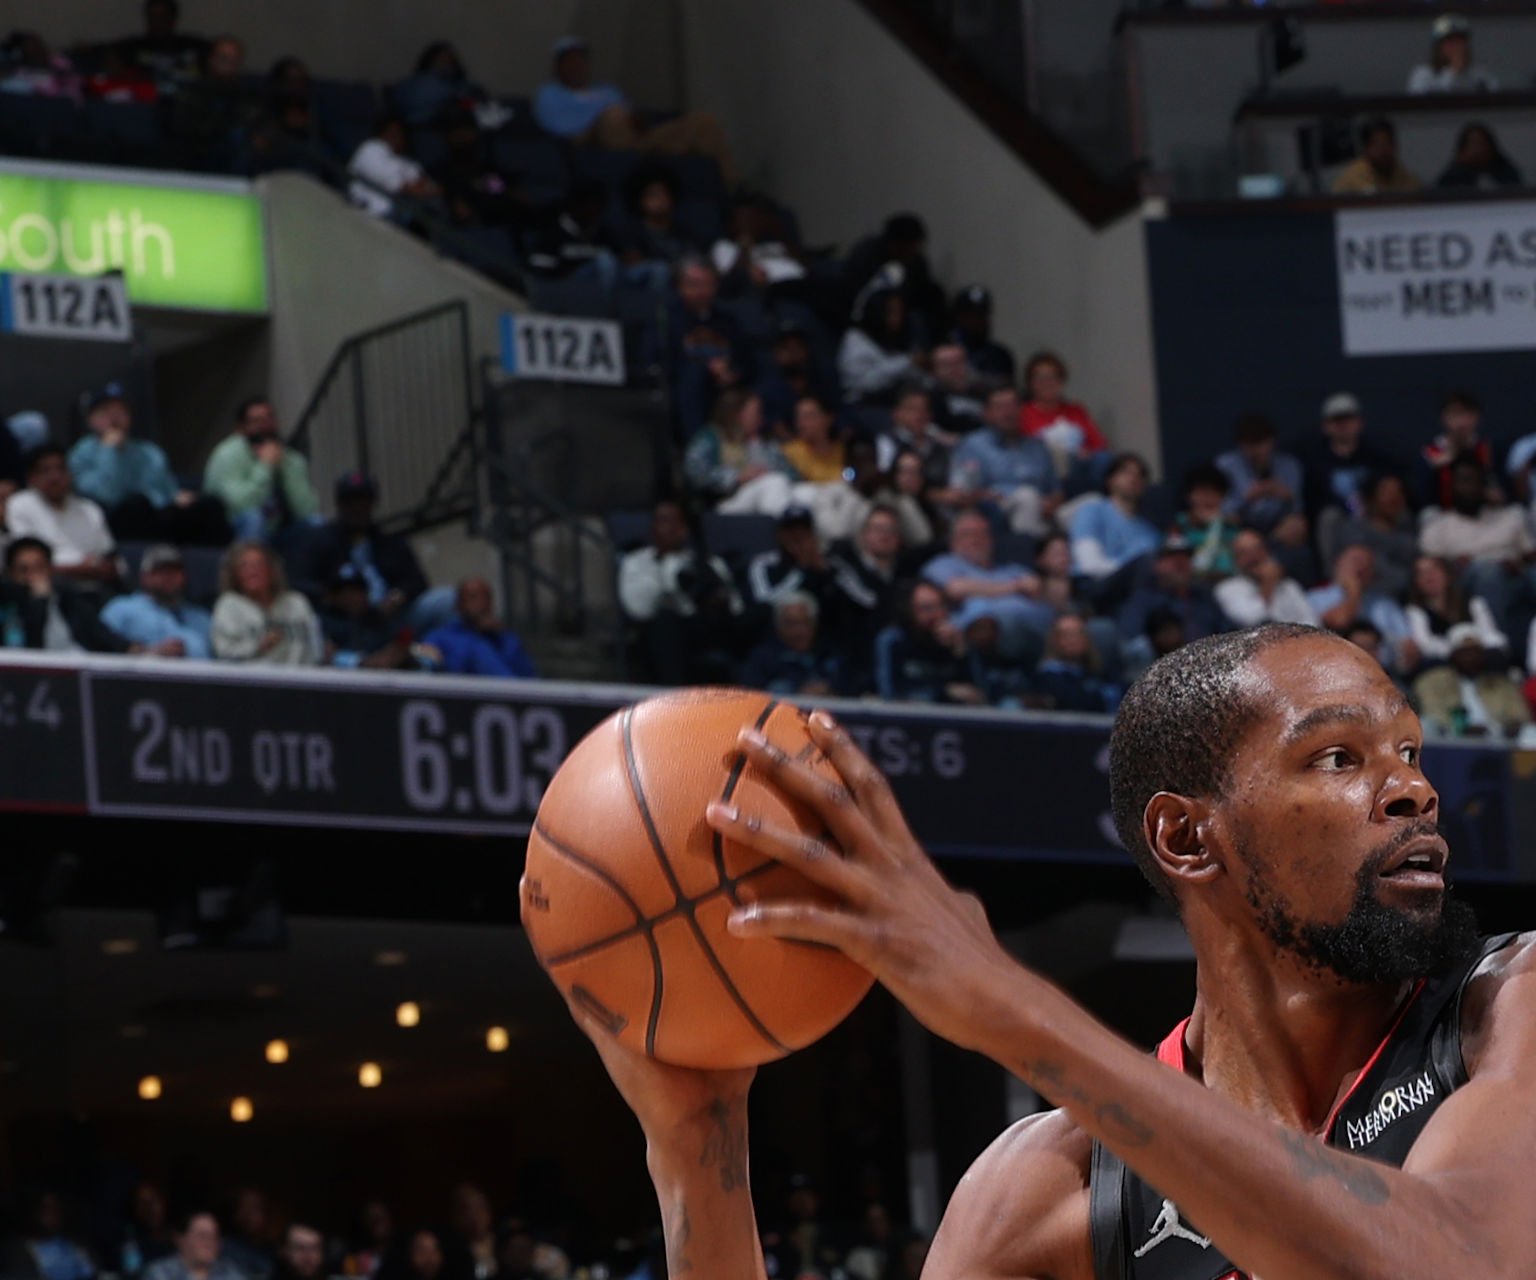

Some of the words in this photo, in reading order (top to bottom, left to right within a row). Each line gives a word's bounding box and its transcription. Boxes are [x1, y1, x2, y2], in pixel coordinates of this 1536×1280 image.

[0, 207, 175, 280] outh
[1343, 231, 1473, 274] NEED
[21, 279, 122, 332] 112A
[1402, 276, 1495, 319] MEM
[522, 325, 615, 374] 112A
[252, 730, 337, 795] QTR
[400, 700, 567, 814] 6:03
